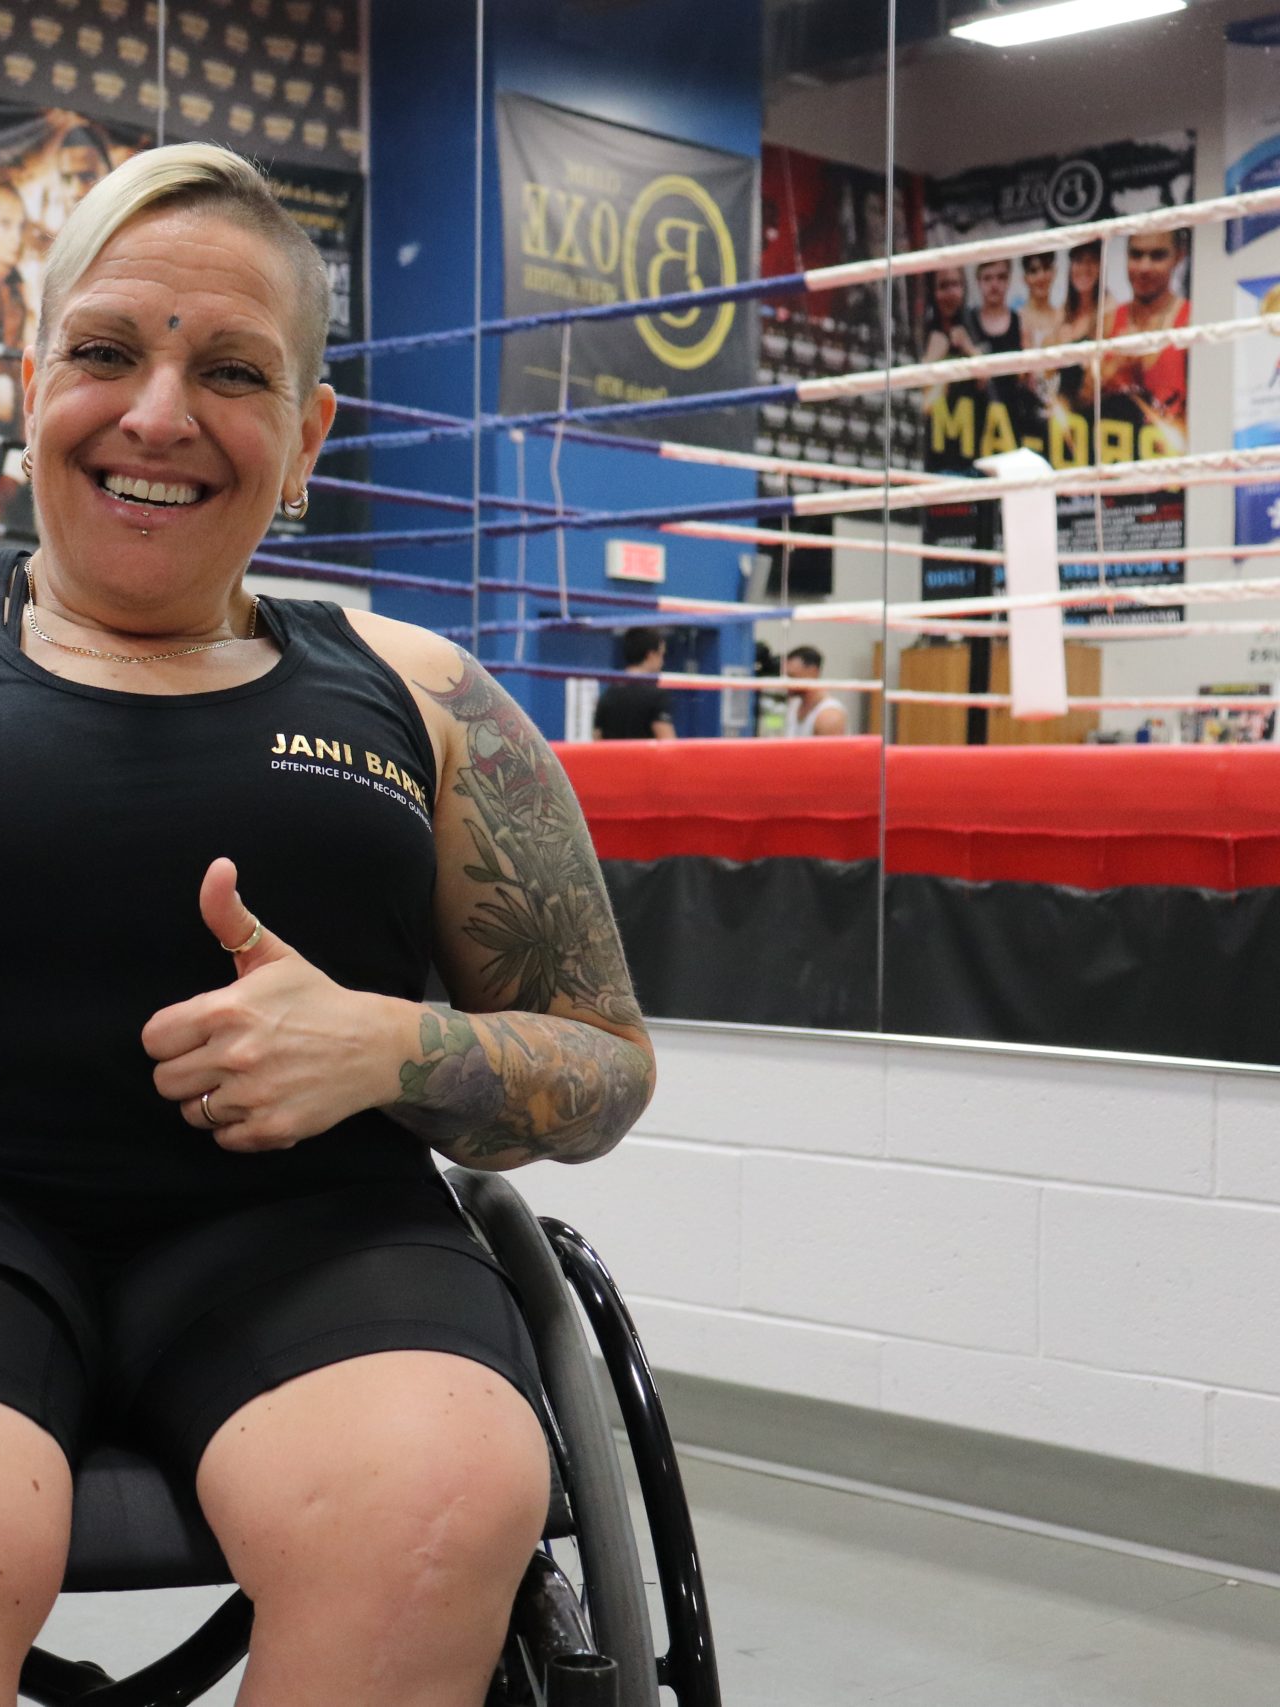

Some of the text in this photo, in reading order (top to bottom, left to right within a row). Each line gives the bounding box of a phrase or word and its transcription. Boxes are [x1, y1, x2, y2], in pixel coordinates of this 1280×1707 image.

[271, 733, 353, 765] JANI
[271, 759, 339, 778] DÉTENTRICE
[343, 771, 370, 787] D'UN
[373, 781, 407, 806] RECORD
